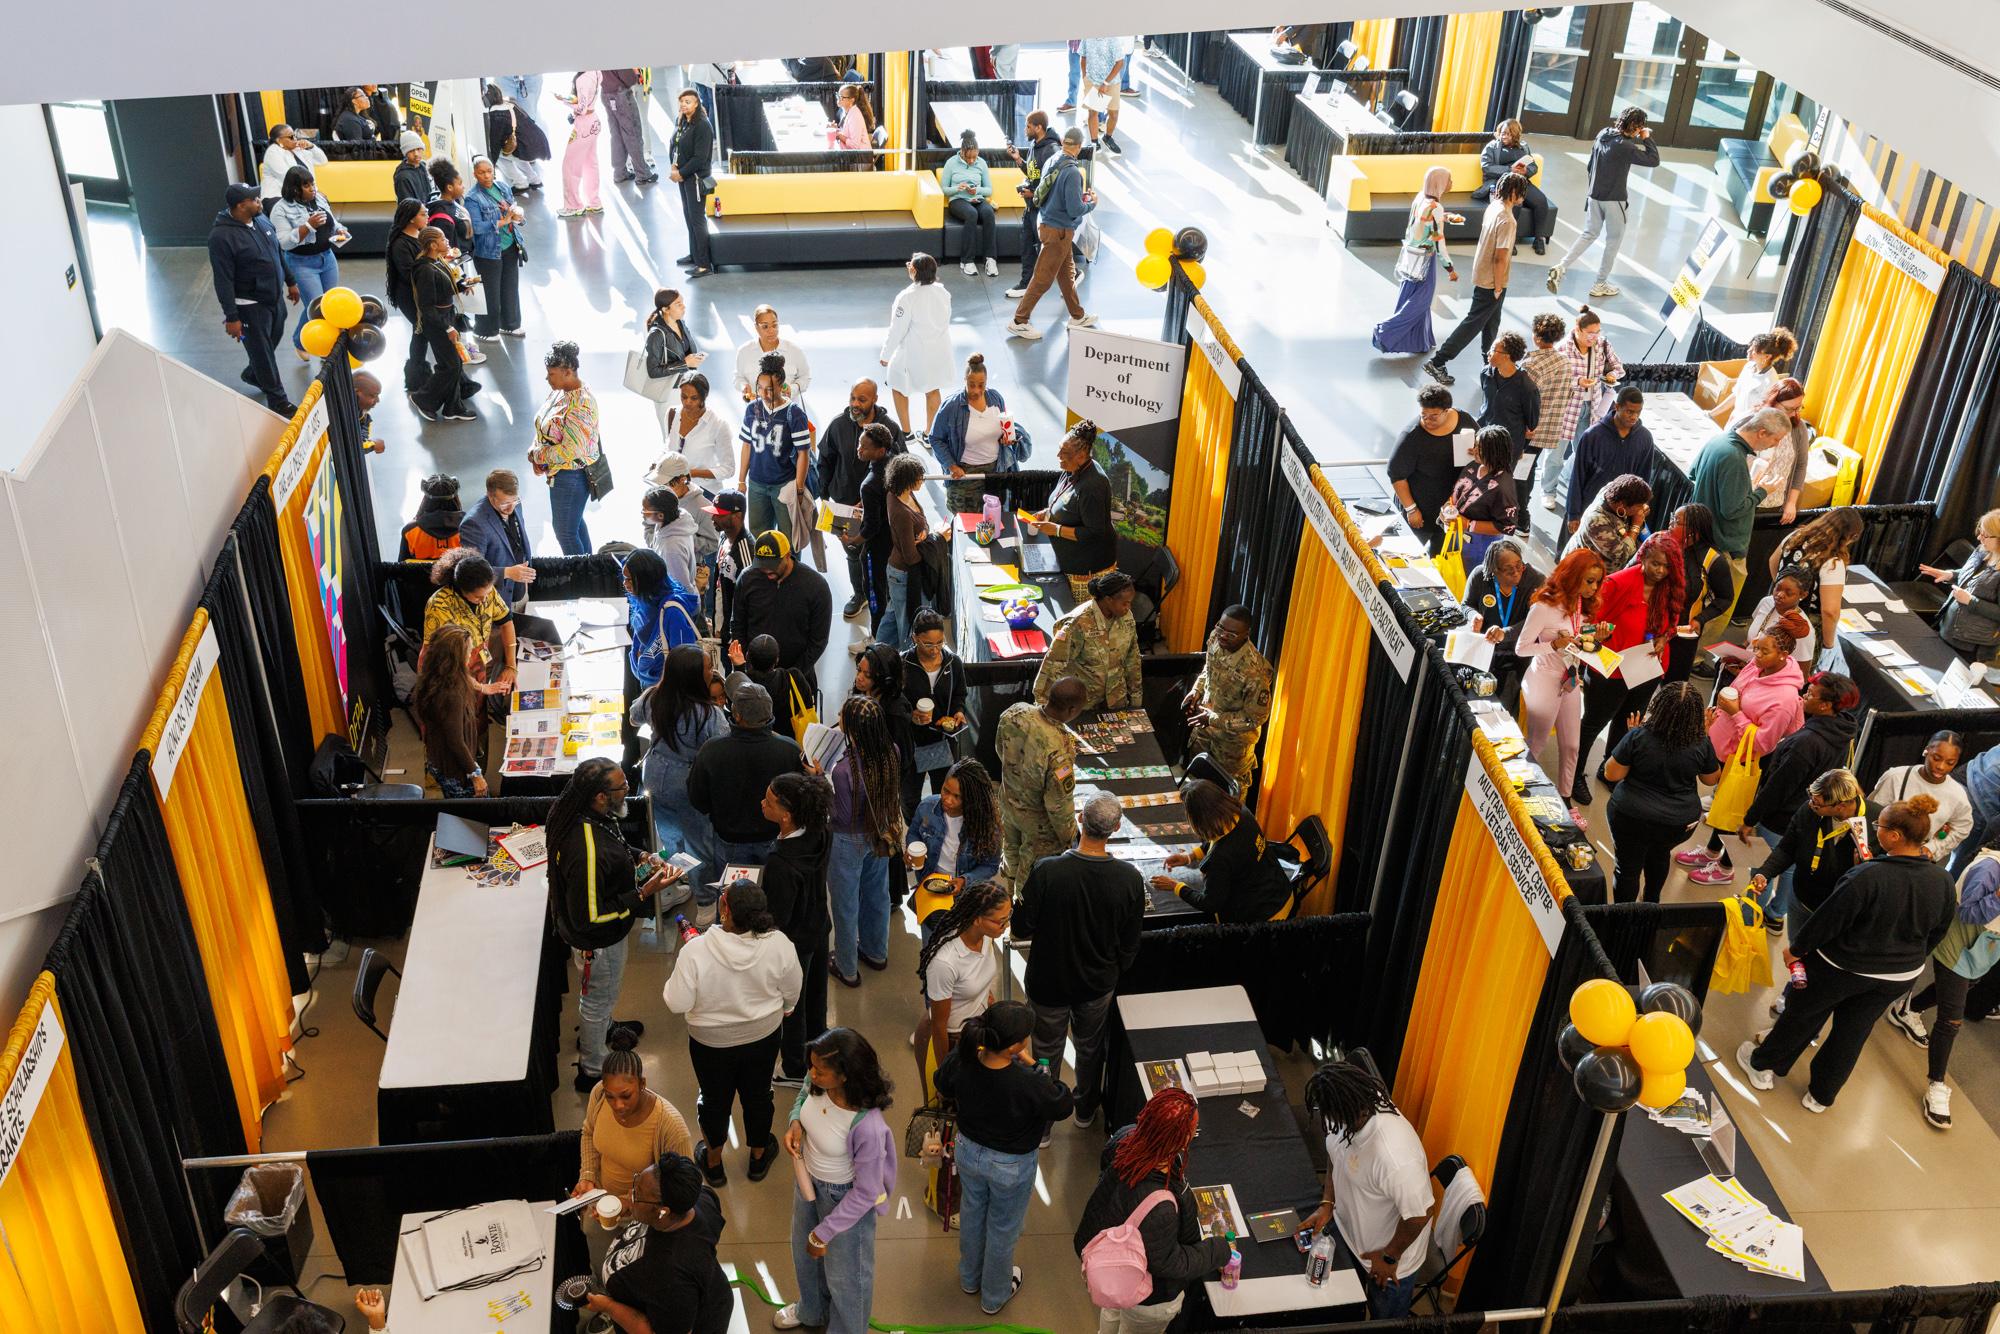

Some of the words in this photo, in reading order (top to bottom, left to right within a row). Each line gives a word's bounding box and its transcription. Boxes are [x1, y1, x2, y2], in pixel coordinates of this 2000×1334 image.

[411, 88, 427, 99] OPEN
[411, 102, 431, 114] HOUSE
[1882, 231, 1910, 257] WELCOME
[1907, 251, 1916, 261] to
[1897, 257, 1928, 282] UNIVERSITY
[1084, 345, 1170, 373] Department
[1117, 373, 1132, 385] of
[1086, 385, 1164, 414] Psychology
[751, 419, 783, 457] 54
[1305, 492, 1326, 526] MILITARY
[1323, 515, 1340, 553] SCIENCE
[1341, 547, 1359, 580] ARMY
[1357, 572, 1373, 603] ROTC
[1369, 596, 1405, 657] DEPARTMENT
[1478, 773, 1507, 822] MILITARY
[1503, 821, 1535, 875] RESOURCE
[1531, 870, 1553, 914] CENTER
[1485, 806, 1510, 857] VETERAN
[1507, 854, 1537, 906] SERVICES
[6, 1022, 47, 1122] SCHOLARSHIPS
[488, 1223, 502, 1255] BOWIE
